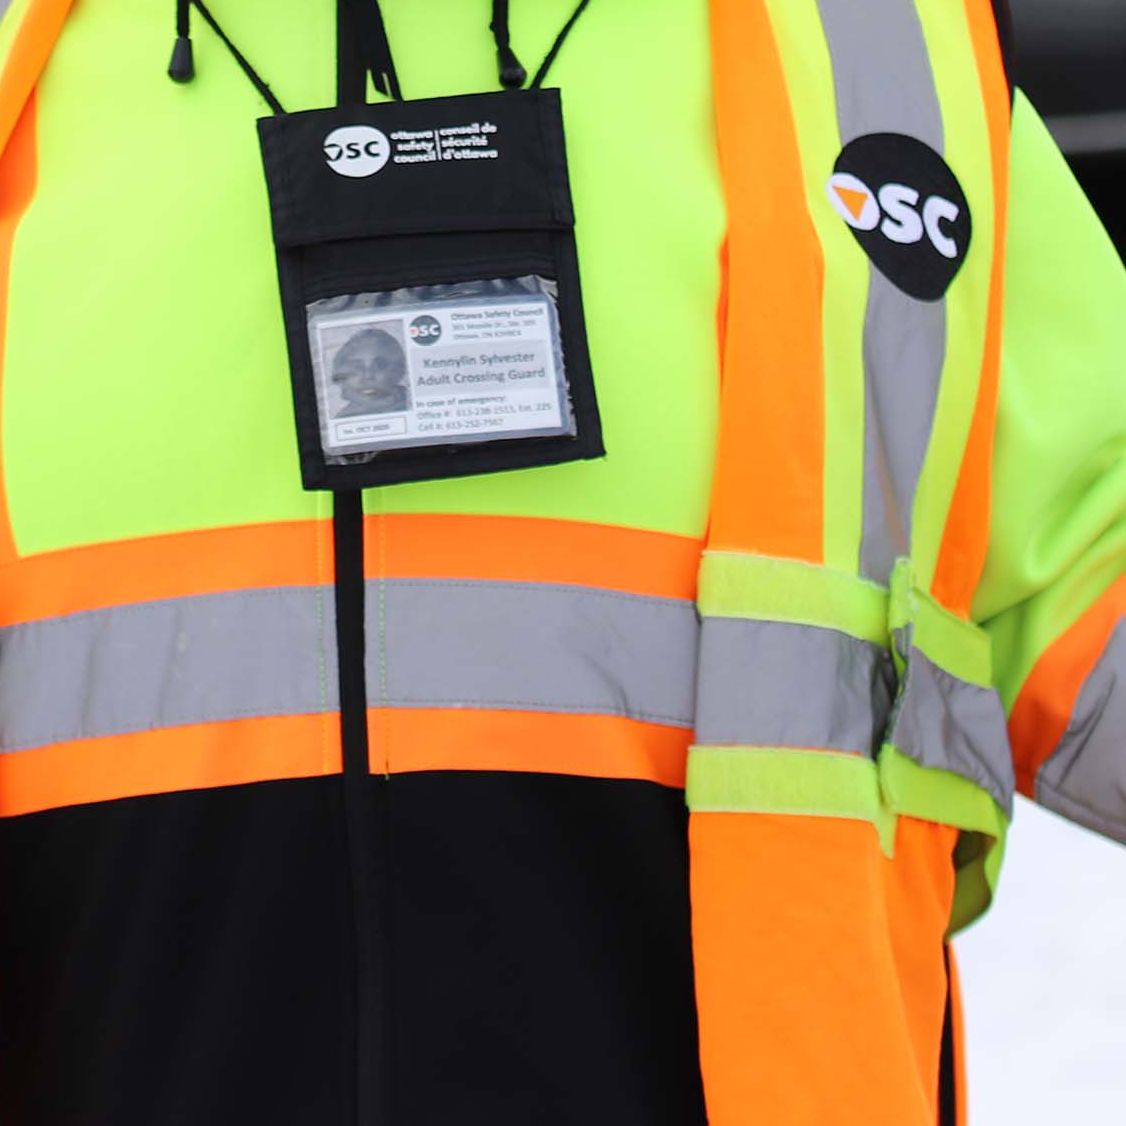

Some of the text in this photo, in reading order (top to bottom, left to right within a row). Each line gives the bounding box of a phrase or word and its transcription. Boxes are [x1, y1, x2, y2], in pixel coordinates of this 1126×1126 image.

[390, 130, 433, 140] ottawa
[440, 122, 497, 136] conseil de
[397, 140, 435, 152] safety
[441, 136, 488, 148] sécurité
[323, 140, 380, 162] OSC
[442, 149, 498, 160] d'ottawa
[393, 152, 436, 164] council
[826, 172, 960, 259] OSC
[451, 307, 544, 321] Ottawa Safety Council
[410, 324, 440, 338] OSC
[423, 353, 535, 368] Kennylin Sylvester
[417, 367, 546, 386] Adult Crossing Guard
[426, 400, 445, 408] case
[447, 397, 456, 405] of
[417, 411, 443, 420] Office
